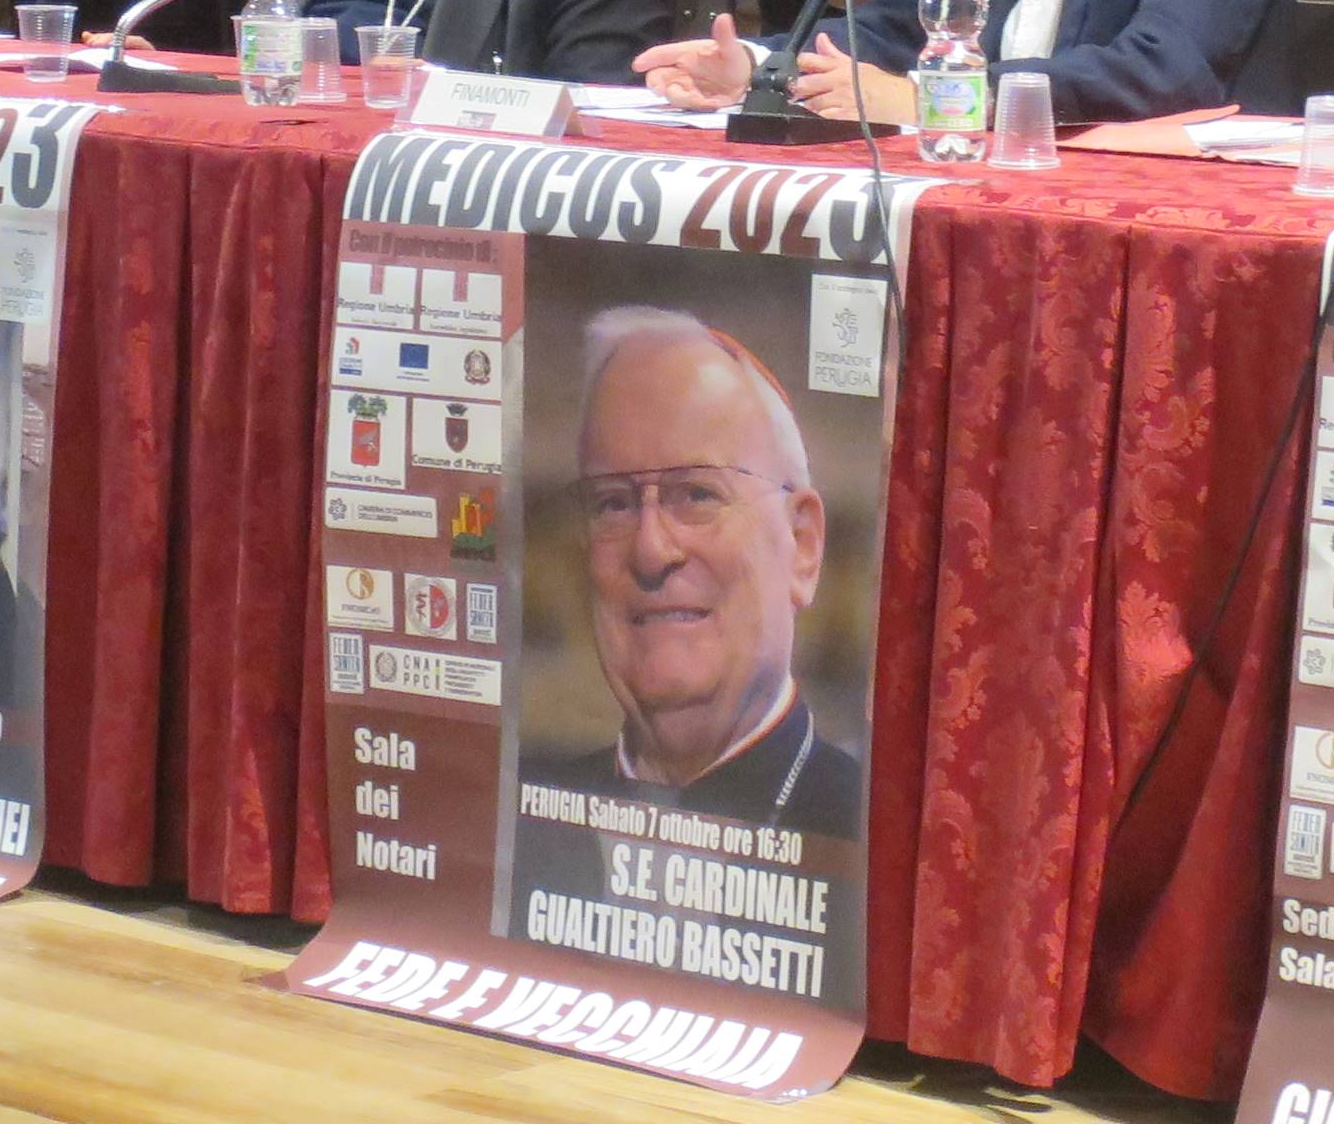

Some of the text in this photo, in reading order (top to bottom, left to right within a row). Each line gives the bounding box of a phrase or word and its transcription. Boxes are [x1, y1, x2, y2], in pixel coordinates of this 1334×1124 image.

[451, 82, 531, 108] FINAMONTI
[349, 134, 931, 265] MEDICUS 2023
[354, 727, 416, 771] Sala
[355, 780, 400, 820] dei
[520, 783, 803, 866] PERUGIA Sabato 7 ottobre ore 16:30
[356, 830, 436, 881] Notari
[610, 843, 829, 935] S.E. CARDINALE
[527, 889, 824, 998] GUALTIERO BASSETTI
[302, 940, 804, 1090] FEDE E VECCHIAIA
